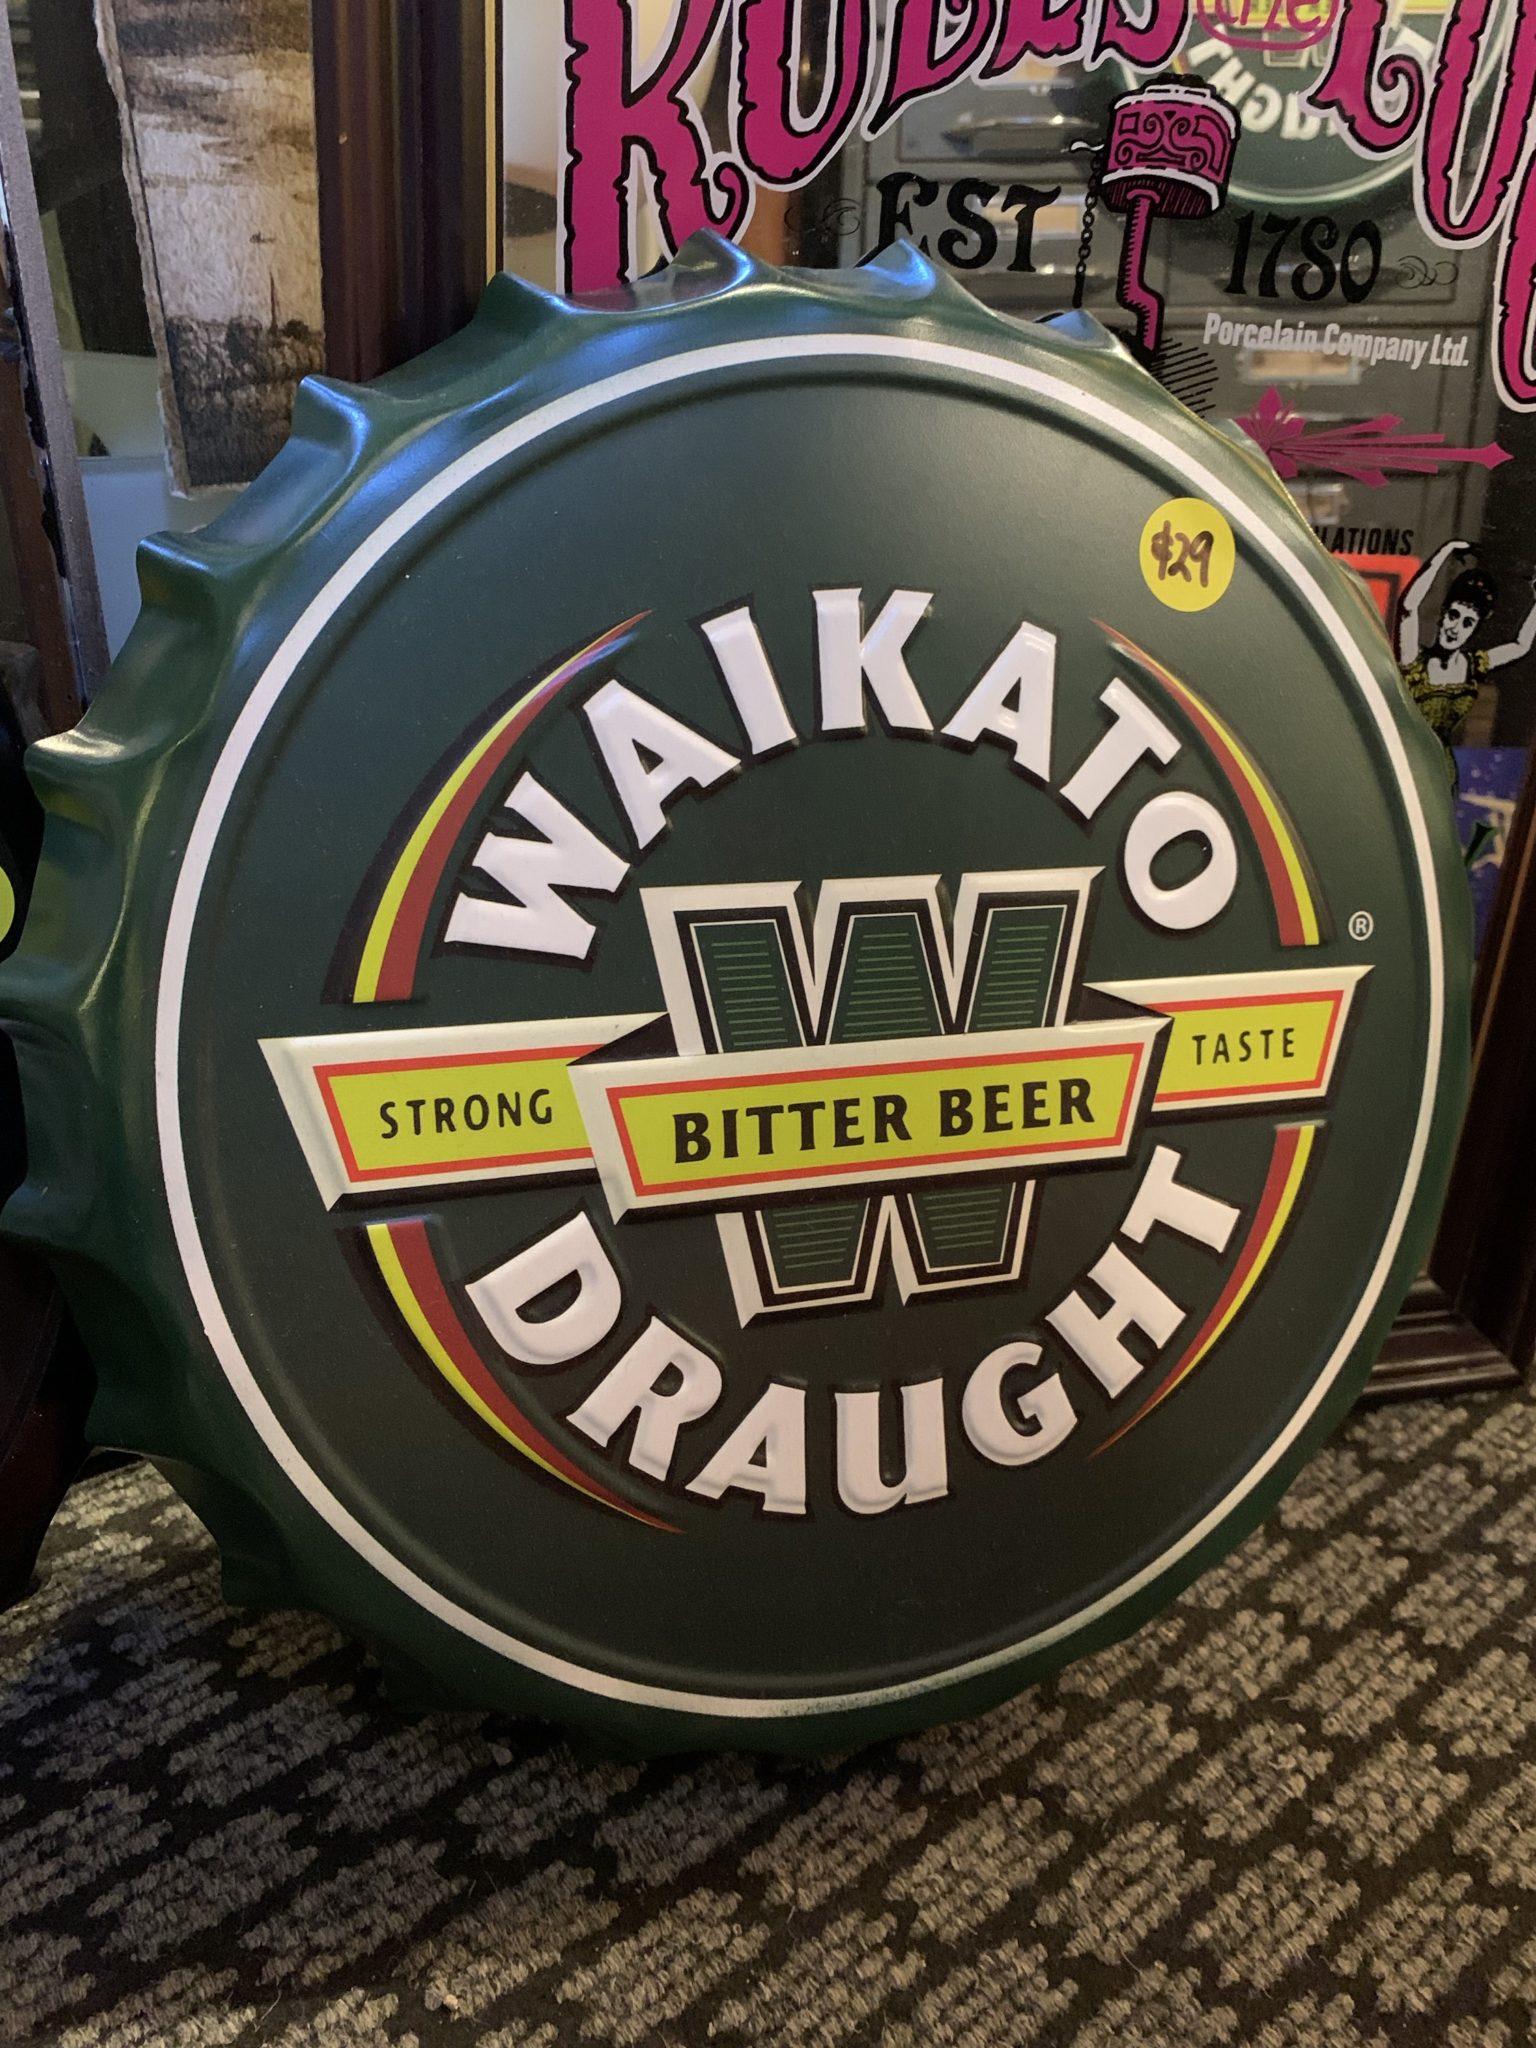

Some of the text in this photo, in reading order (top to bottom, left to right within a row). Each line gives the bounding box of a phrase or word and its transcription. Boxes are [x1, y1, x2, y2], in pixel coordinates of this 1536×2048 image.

[856, 171, 1382, 302] EST 1780
[1202, 312, 1469, 369] Porcelain Company Ltd.
[1151, 519, 1214, 588] $29
[444, 587, 1238, 960] WAIKATO
[380, 1027, 1296, 1164] STRONG BITTER BEER TASTE
[465, 1145, 1241, 1515] DRAUGHT
